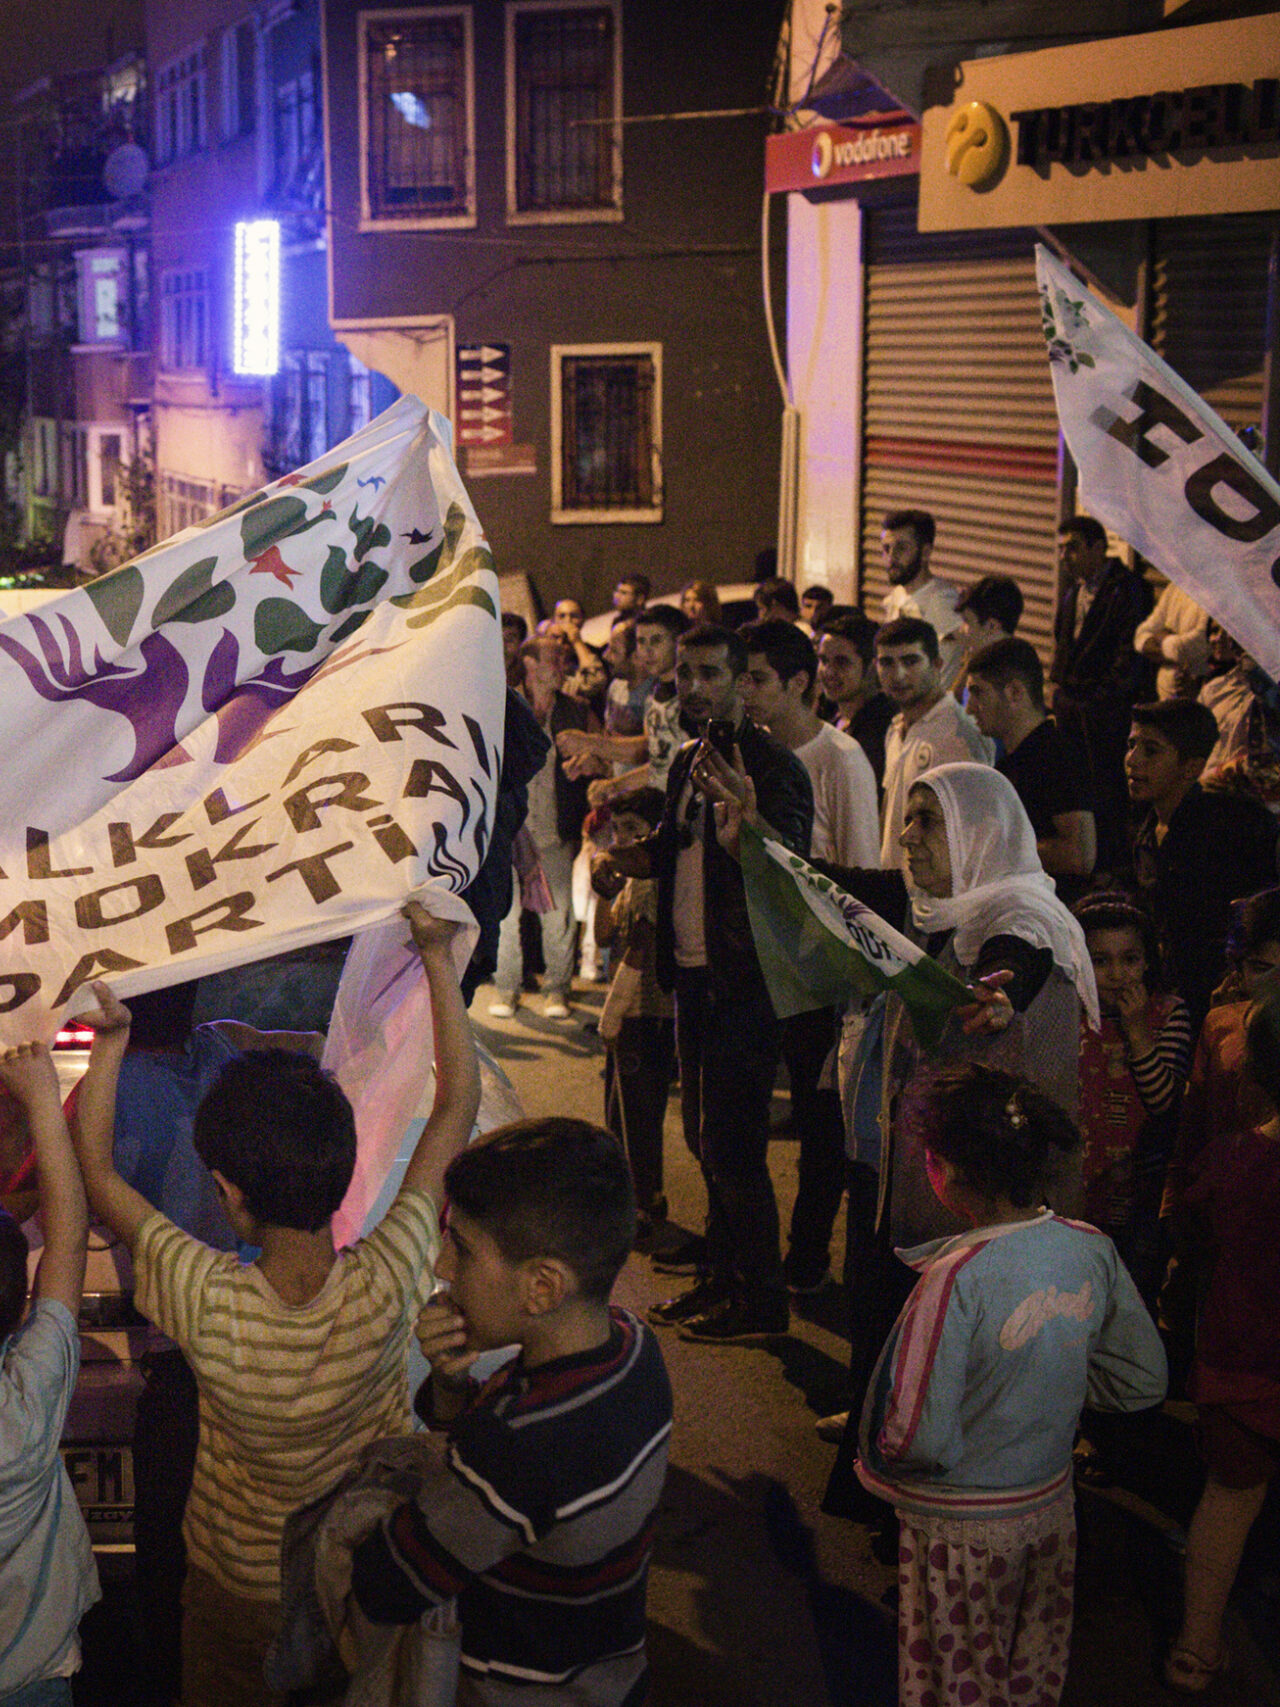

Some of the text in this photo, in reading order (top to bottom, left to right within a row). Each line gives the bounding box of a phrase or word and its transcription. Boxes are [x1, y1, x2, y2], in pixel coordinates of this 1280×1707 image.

[834, 131, 909, 166] vodafone
[1010, 78, 1280, 166] TURKCELL
[1087, 379, 1280, 592] HD
